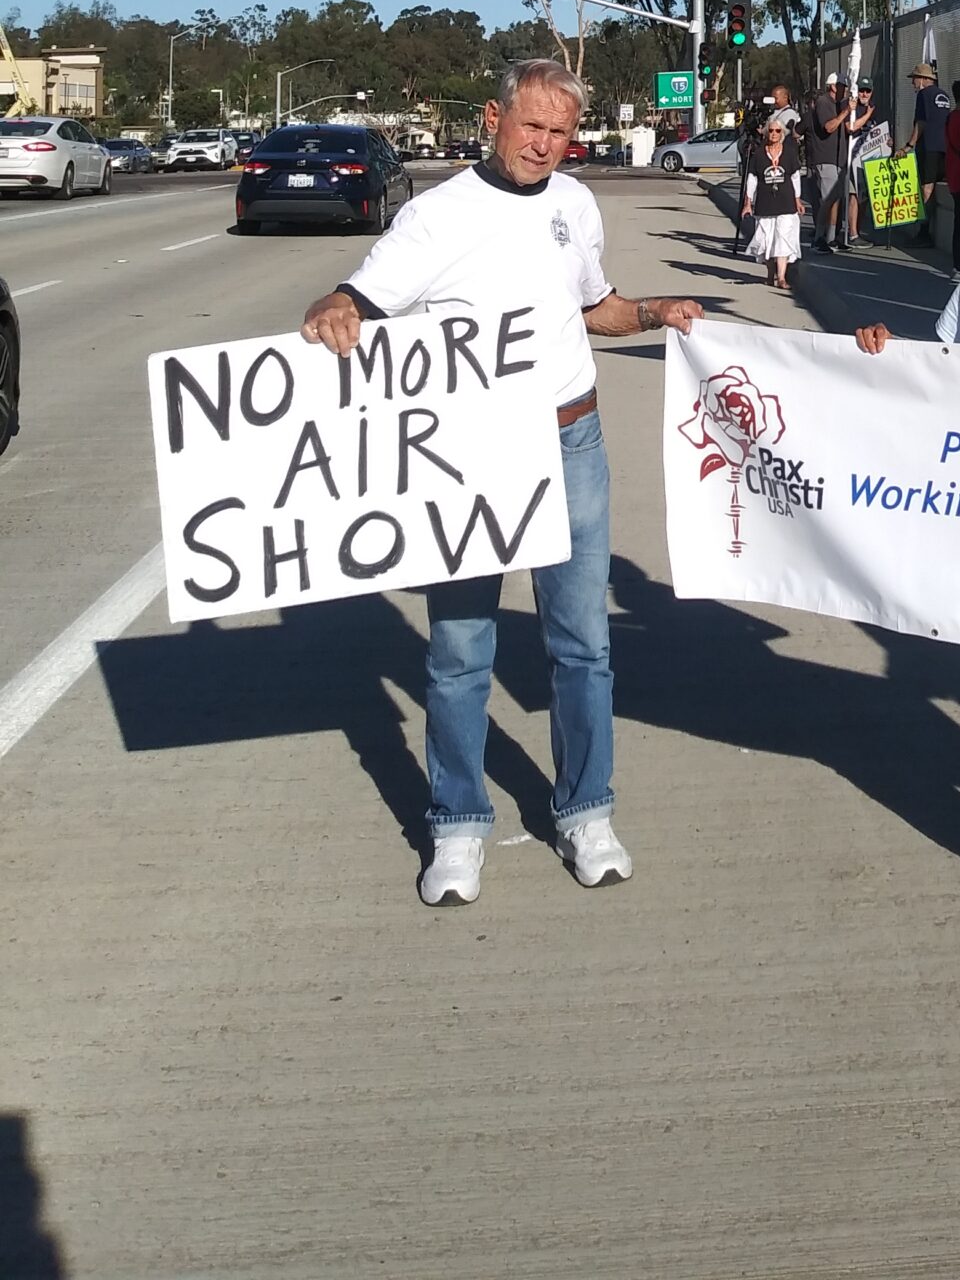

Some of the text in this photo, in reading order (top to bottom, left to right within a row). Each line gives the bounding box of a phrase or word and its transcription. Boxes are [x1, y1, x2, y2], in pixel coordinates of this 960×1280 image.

[675, 82, 686, 90] 15
[874, 170, 910, 186] SHOW
[164, 347, 294, 453] NO
[758, 447, 804, 482] Pax
[745, 464, 825, 510] Christi
[767, 497, 794, 519] USA
[183, 476, 551, 603] SHOW
